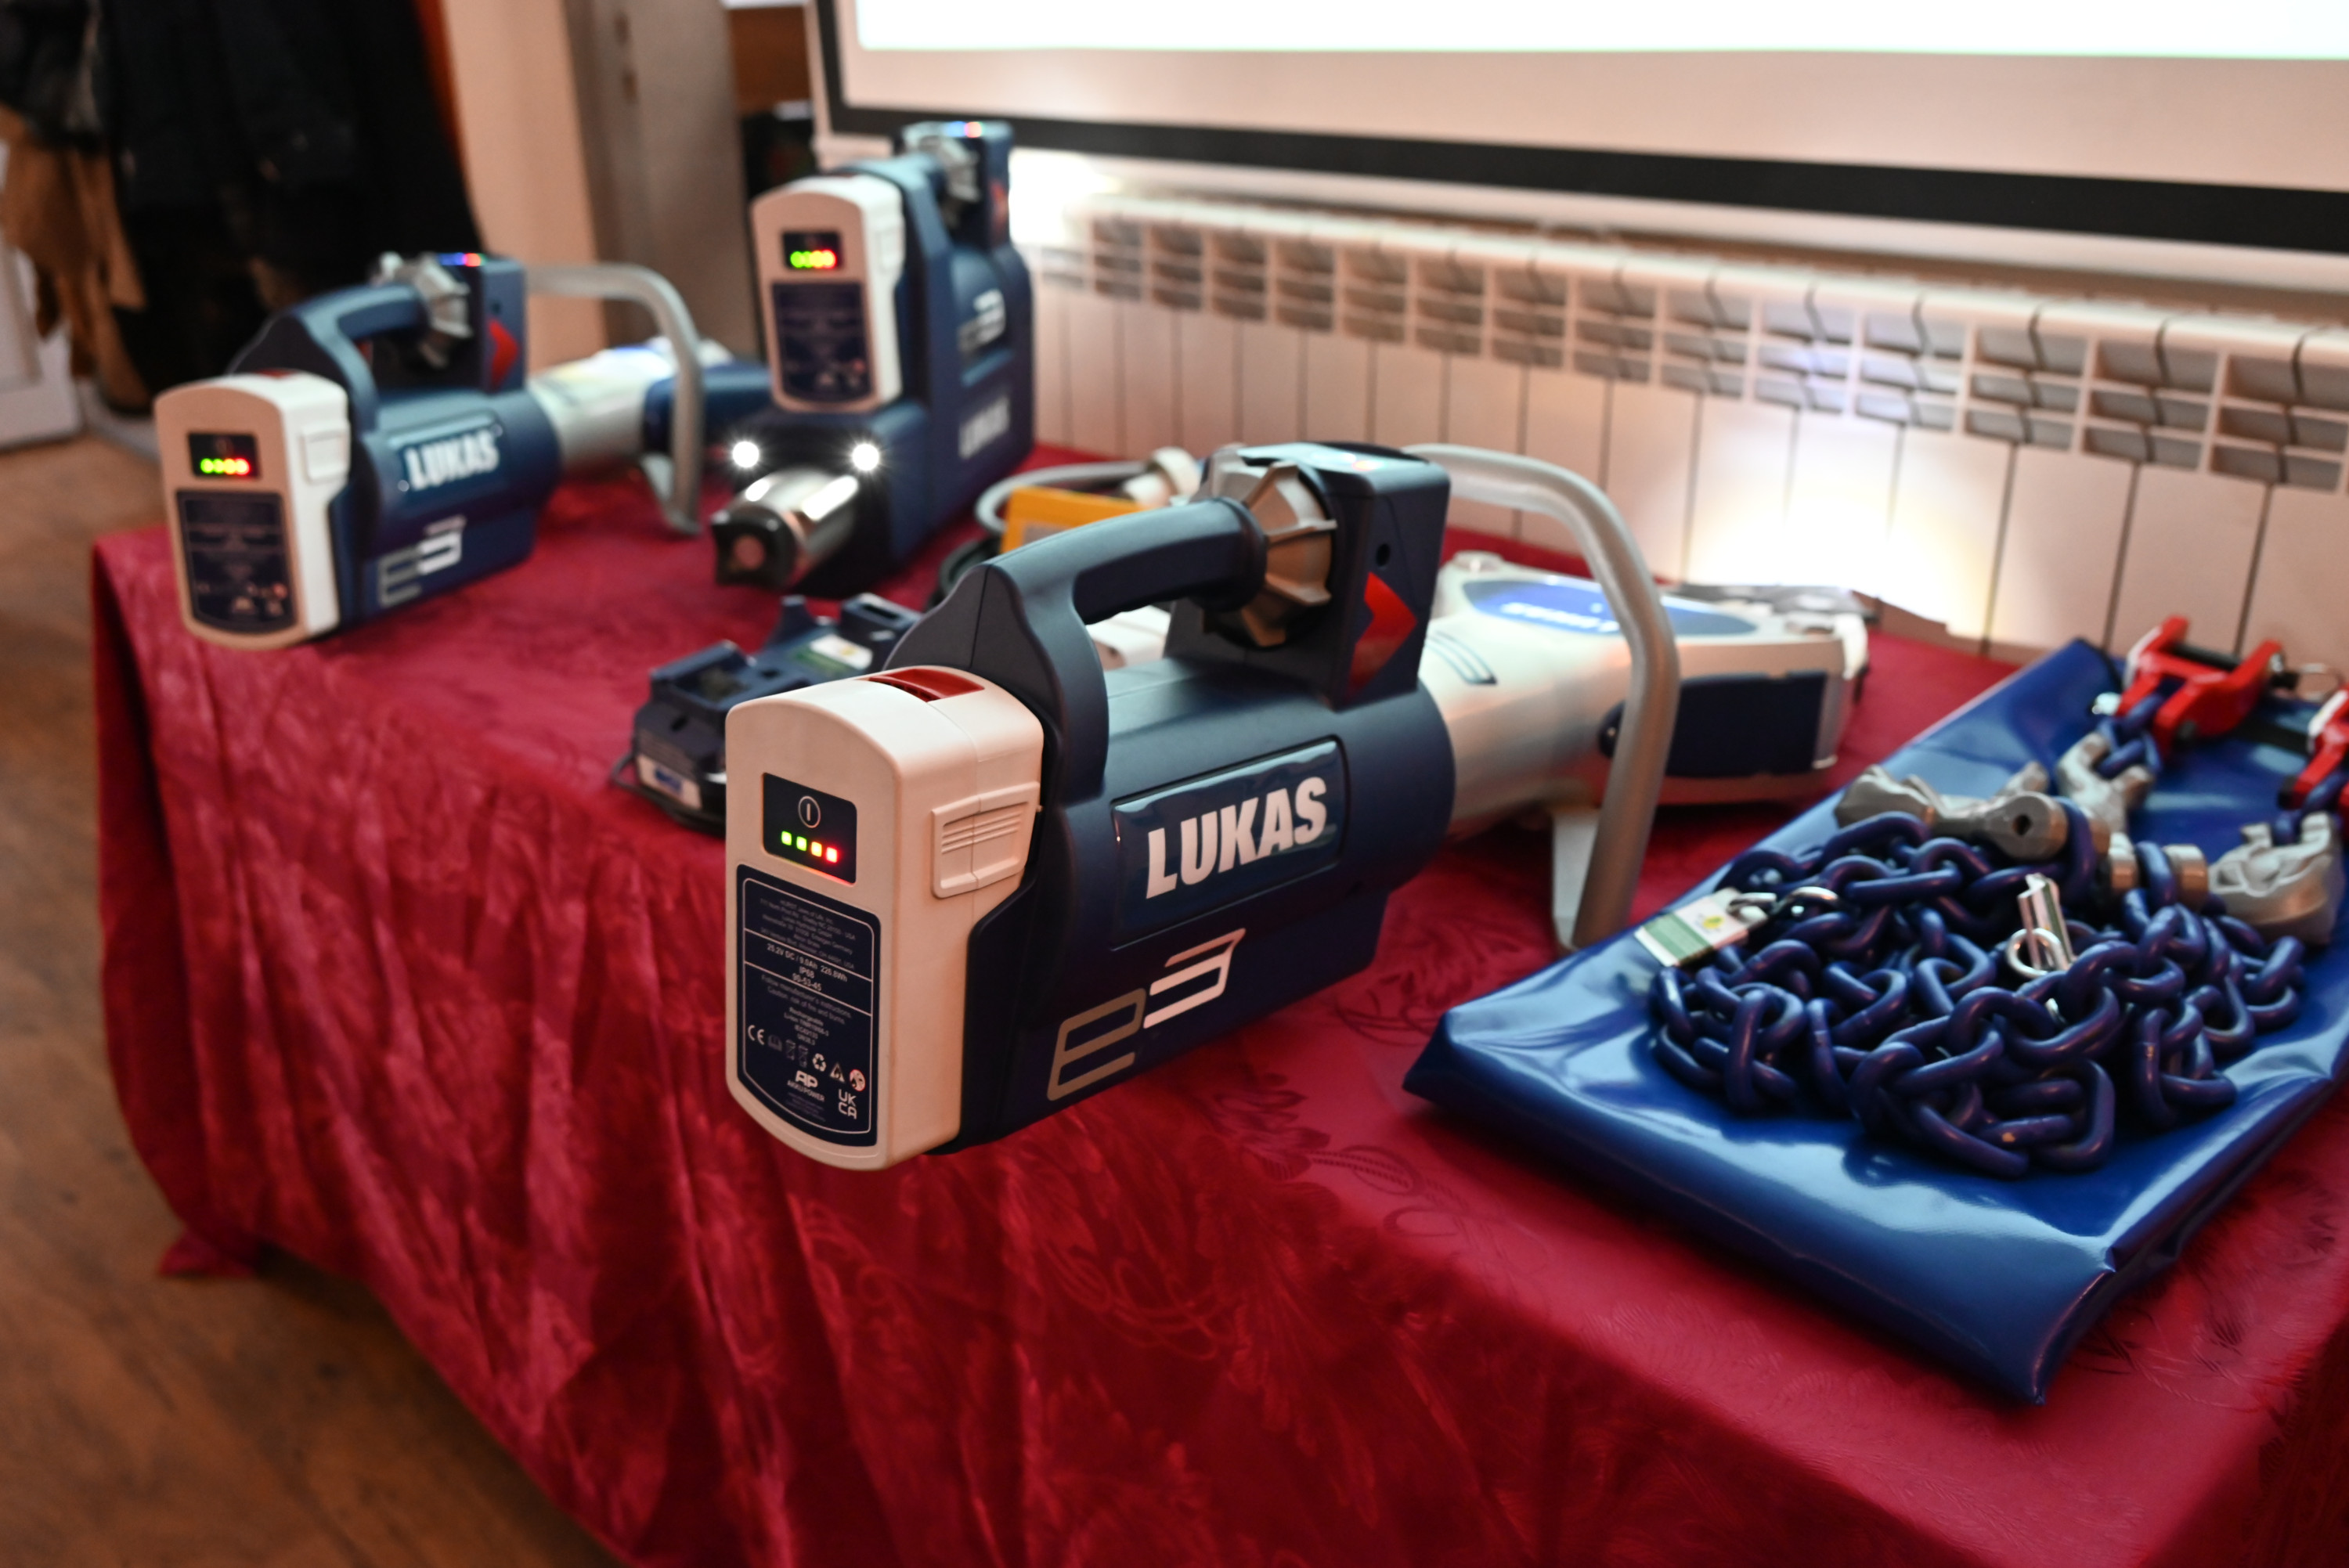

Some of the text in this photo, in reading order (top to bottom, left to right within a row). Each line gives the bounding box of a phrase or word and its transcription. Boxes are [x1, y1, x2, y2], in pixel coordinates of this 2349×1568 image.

[405, 429, 500, 492] LUKAS
[1145, 776, 1328, 899] LUKAS
[767, 943, 784, 956] 25.2V
[785, 950, 795, 961] DC
[799, 956, 817, 970] 9.0Ah
[799, 965, 814, 979] IP68
[795, 1069, 818, 1088] AP
[838, 1088, 857, 1108] UK
[837, 1101, 857, 1120] CA
